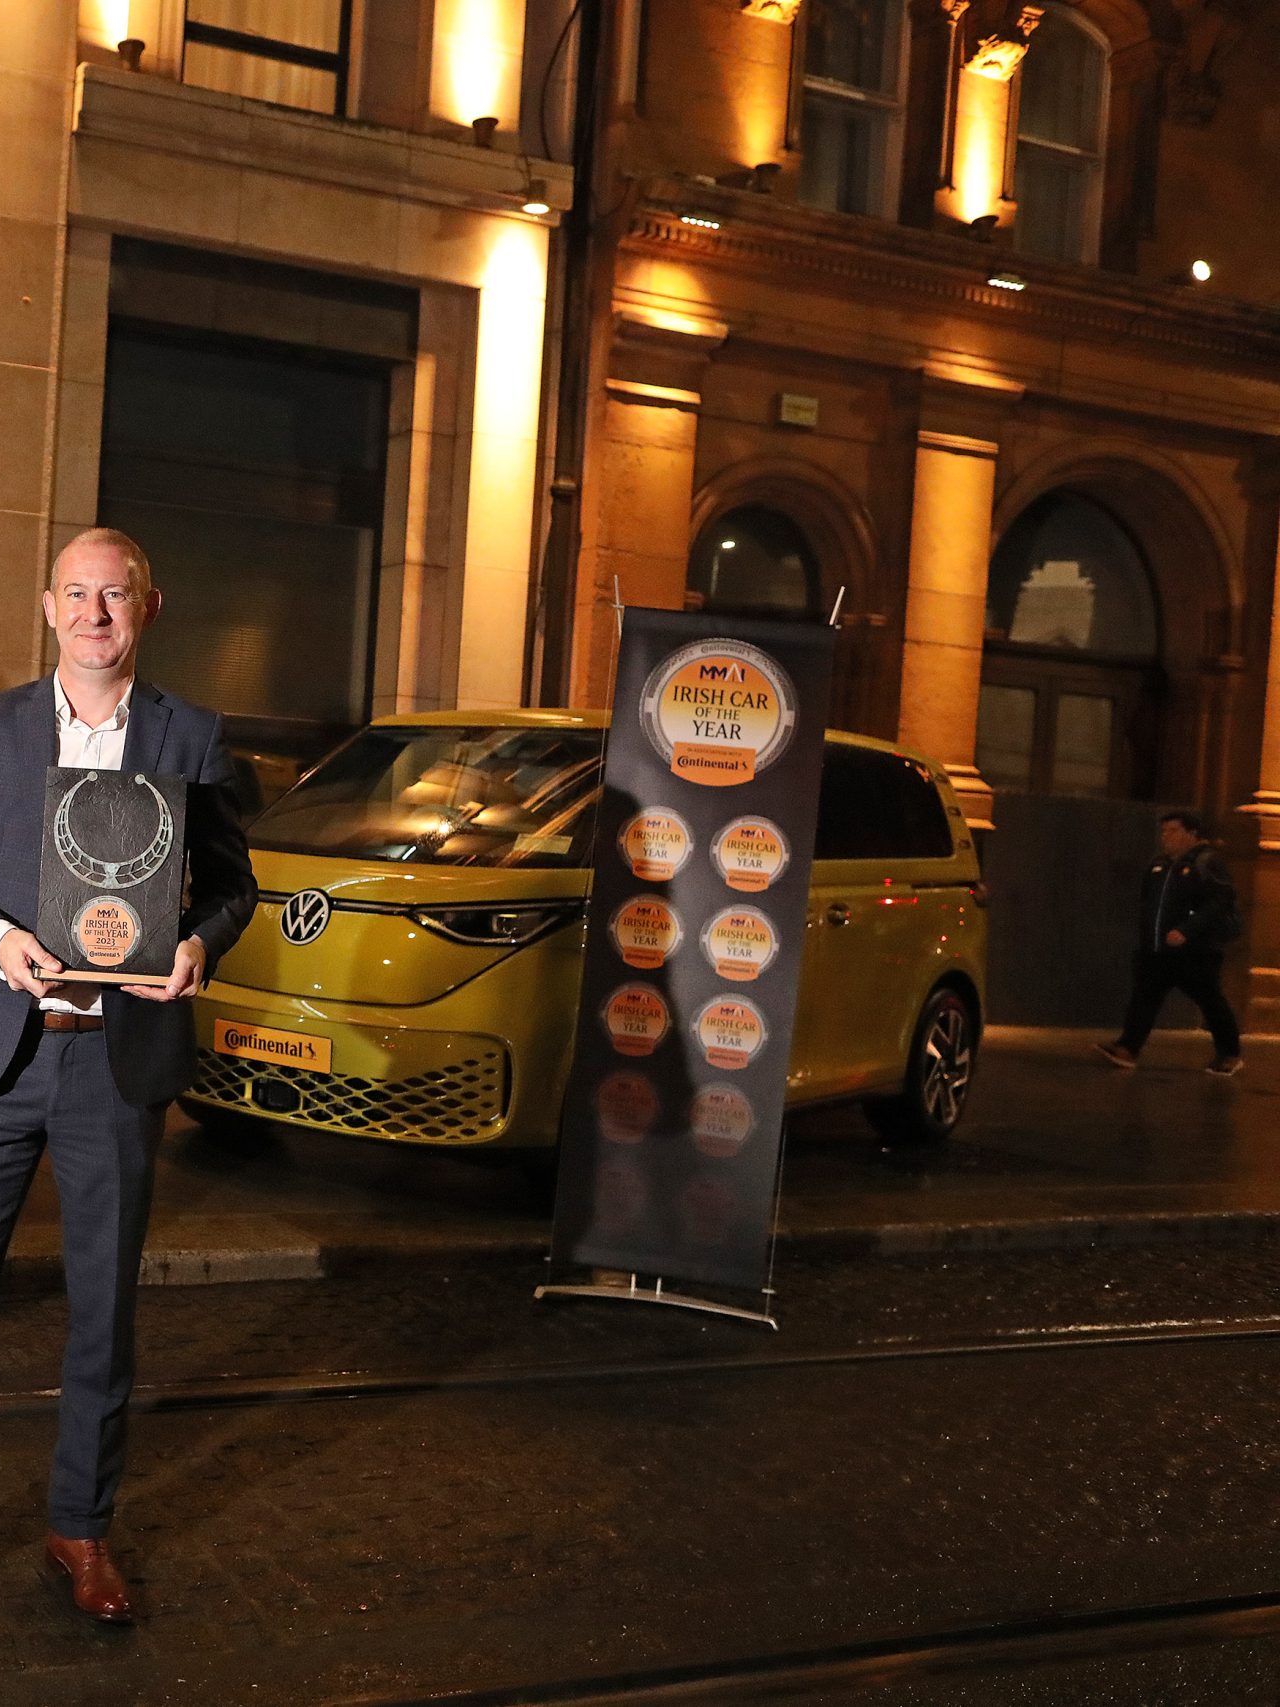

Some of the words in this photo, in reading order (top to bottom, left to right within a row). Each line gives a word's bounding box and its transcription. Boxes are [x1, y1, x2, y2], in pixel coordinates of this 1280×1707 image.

[673, 685, 725, 705] IRISH
[730, 690, 769, 710] CAR
[695, 706, 712, 718] OF
[716, 708, 741, 720] THE
[693, 719, 741, 740] YEAR
[677, 755, 738, 770] Continental
[633, 830, 659, 841] IRISH
[661, 832, 681, 843] CAR
[643, 847, 668, 858] YEAR
[727, 839, 754, 851] IRISH
[756, 842, 776, 853] CAR
[737, 857, 762, 868] YEAR
[85, 919, 109, 929] IRISH
[111, 921, 128, 930] CAR
[623, 917, 650, 928] IRISH
[651, 920, 671, 931] CAR
[107, 930, 129, 939] YEAR
[633, 934, 658, 946] YEAR
[716, 928, 744, 940] IRISH
[746, 931, 766, 942] CAR
[96, 937, 116, 946] 2023
[726, 945, 752, 957] YEAR
[224, 1028, 303, 1058] Continental
[716, 1034, 742, 1047] YEAR
